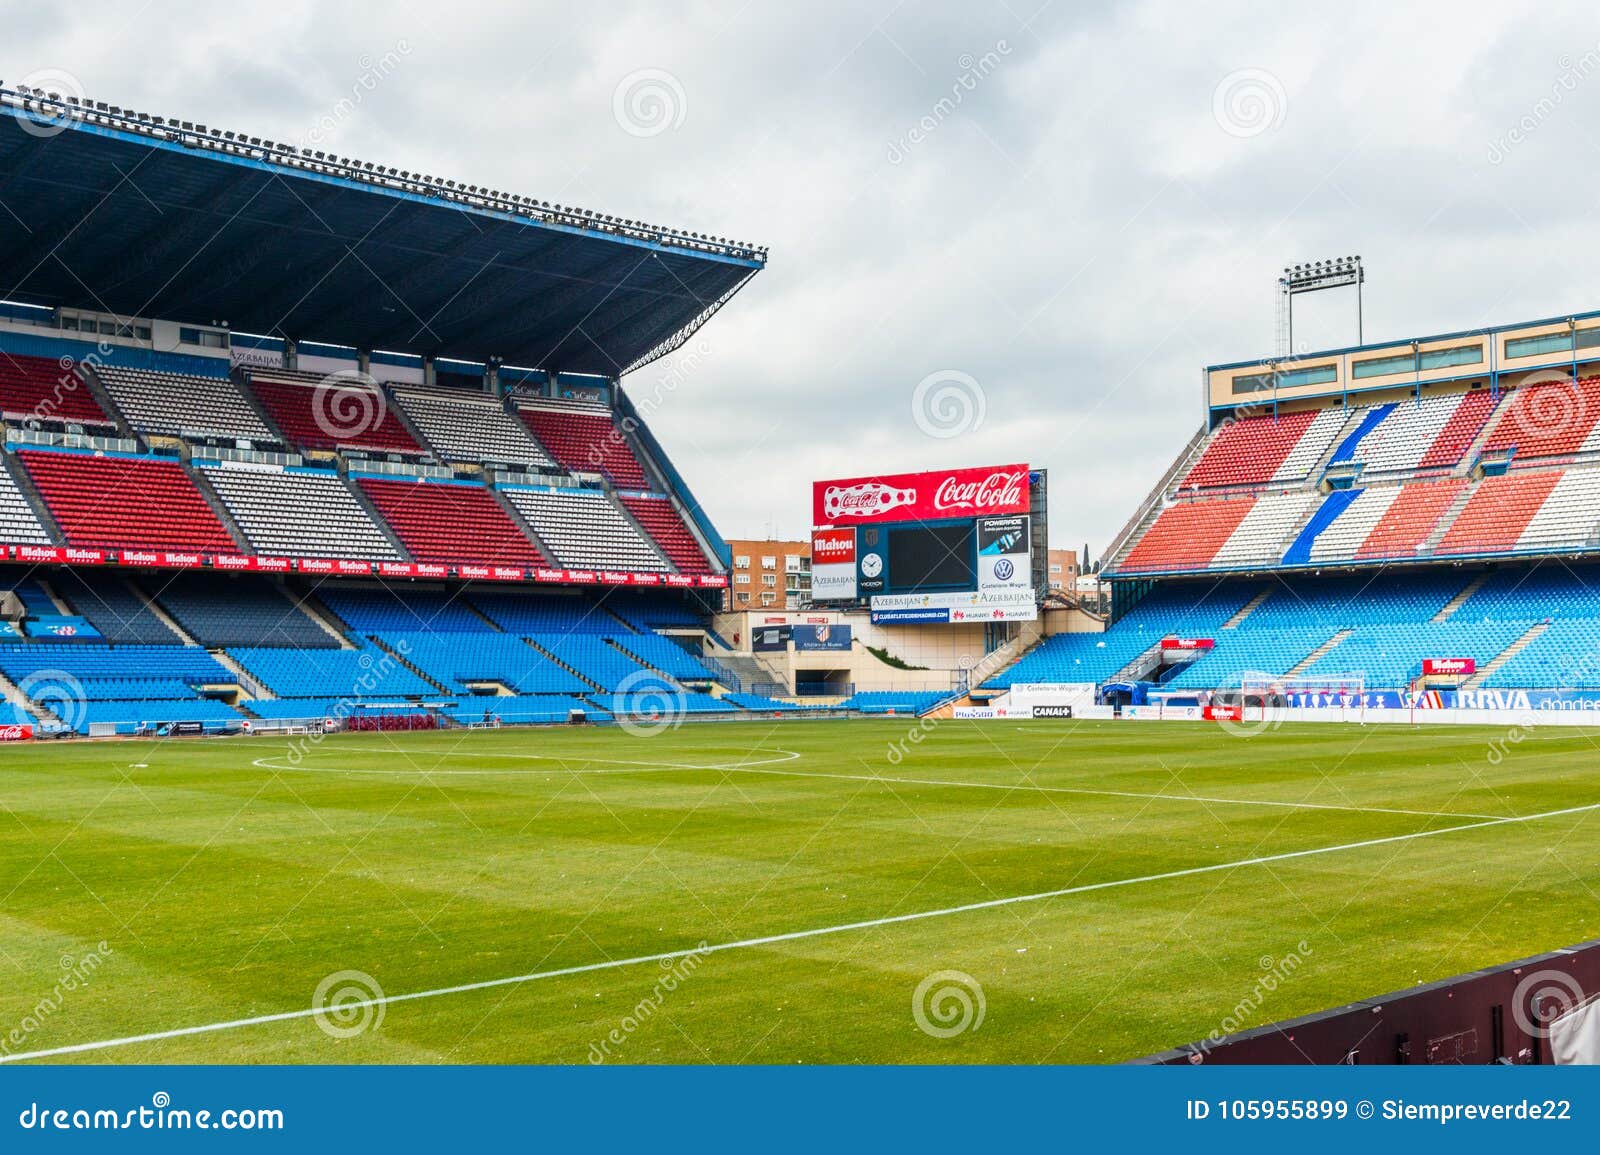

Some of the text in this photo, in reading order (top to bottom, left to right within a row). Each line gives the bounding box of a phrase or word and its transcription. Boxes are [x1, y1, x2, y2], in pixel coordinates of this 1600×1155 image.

[814, 538, 853, 551] Mahou
[21, 547, 100, 559] Mahou Mahou
[124, 552, 197, 563] Mahou Mahou
[218, 556, 287, 567] Mahou Mahou
[303, 560, 367, 570] Mahou Mahou
[383, 563, 444, 573] Mahou Mahou
[813, 576, 855, 586] AZERBAIJAN
[873, 597, 920, 607] AZERBAIJAN
[980, 593, 1032, 604] AZERBAIJAN
[1033, 707, 1070, 716] CANAL+
